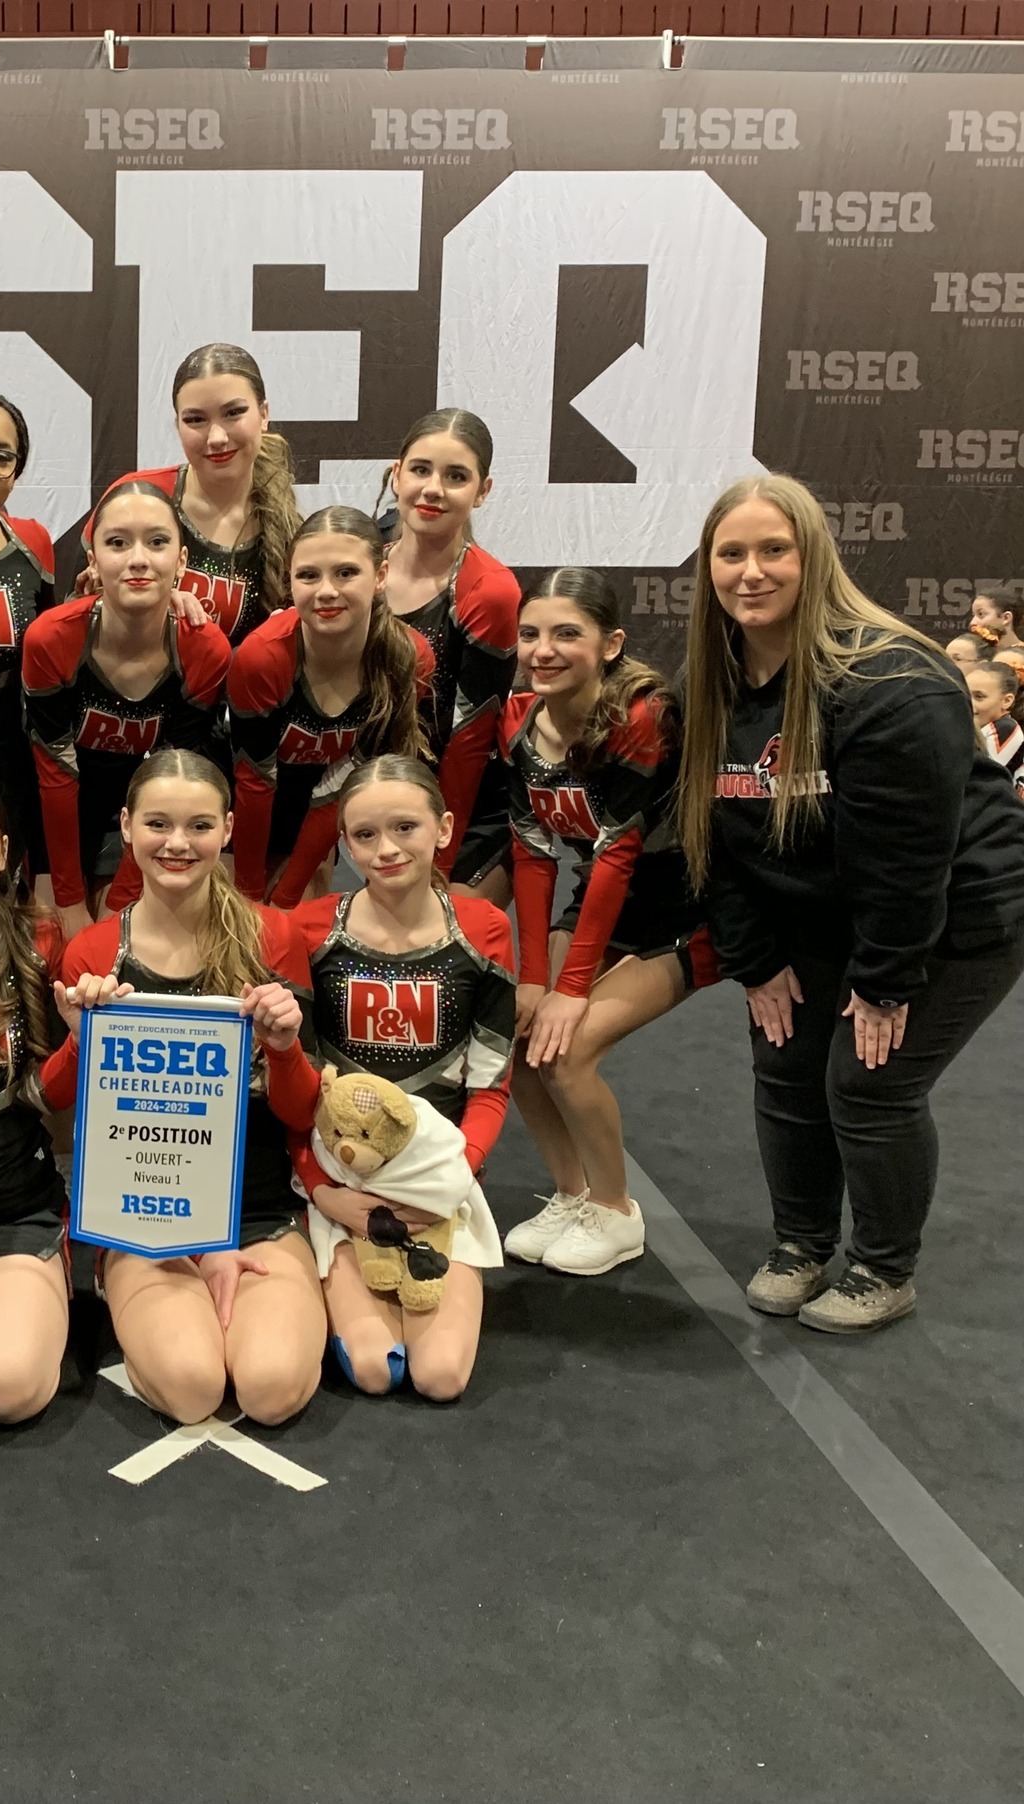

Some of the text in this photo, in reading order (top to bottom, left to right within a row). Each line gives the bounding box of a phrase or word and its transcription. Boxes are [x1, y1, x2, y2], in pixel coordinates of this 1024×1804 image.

[84, 108, 224, 150] RSEQ
[370, 108, 512, 150] RSEQ
[659, 107, 800, 150] RSEQ
[945, 110, 1024, 152] RS
[117, 153, 184, 165] MONTÉRÉGIE
[403, 153, 471, 165] MONTÉRÉGIE
[691, 153, 759, 165] MONTÉRÉGIE
[795, 190, 935, 232] RSEQ
[827, 236, 894, 247] MONTÉRÉGIE
[930, 272, 1024, 313] RSE
[785, 350, 922, 391] RSEQ
[815, 394, 882, 405] MONTÉRÉGIE
[916, 429, 1024, 469] RSE
[631, 576, 696, 614] RS
[526, 782, 600, 840] R&N
[347, 978, 439, 1047] R&N
[100, 1036, 229, 1078] RSEQ
[99, 1076, 224, 1097] CHEERLEADING
[134, 1100, 190, 1113] 2024-2025
[128, 1125, 212, 1145] POSITION
[135, 1151, 183, 1166] OUVERT
[134, 1171, 181, 1185] Niveau 1
[121, 1194, 192, 1218] RSEQ
